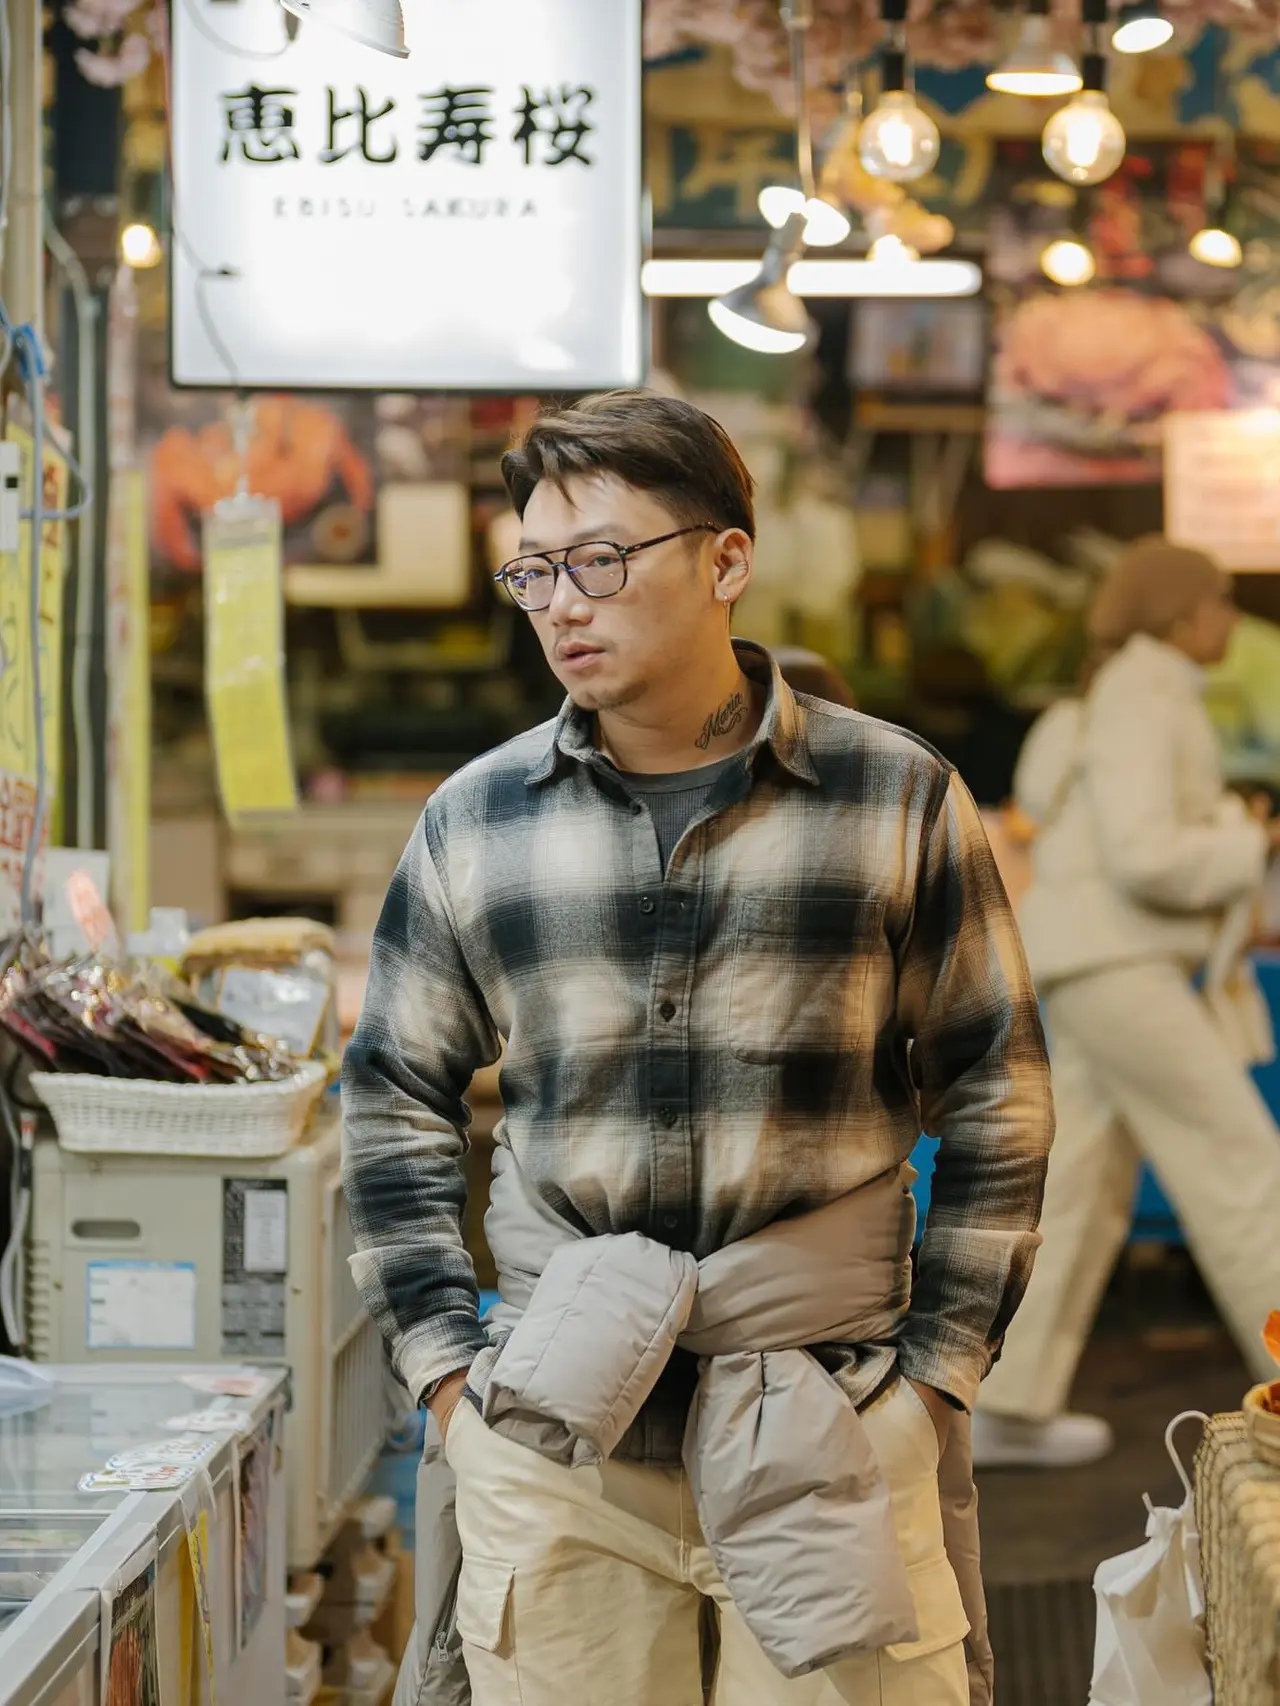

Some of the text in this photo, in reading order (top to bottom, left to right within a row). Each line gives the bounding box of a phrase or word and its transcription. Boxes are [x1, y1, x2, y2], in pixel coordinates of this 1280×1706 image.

[219, 84, 595, 166] 恵比寿桜
[272, 196, 538, 218] EBISU SAKURA
